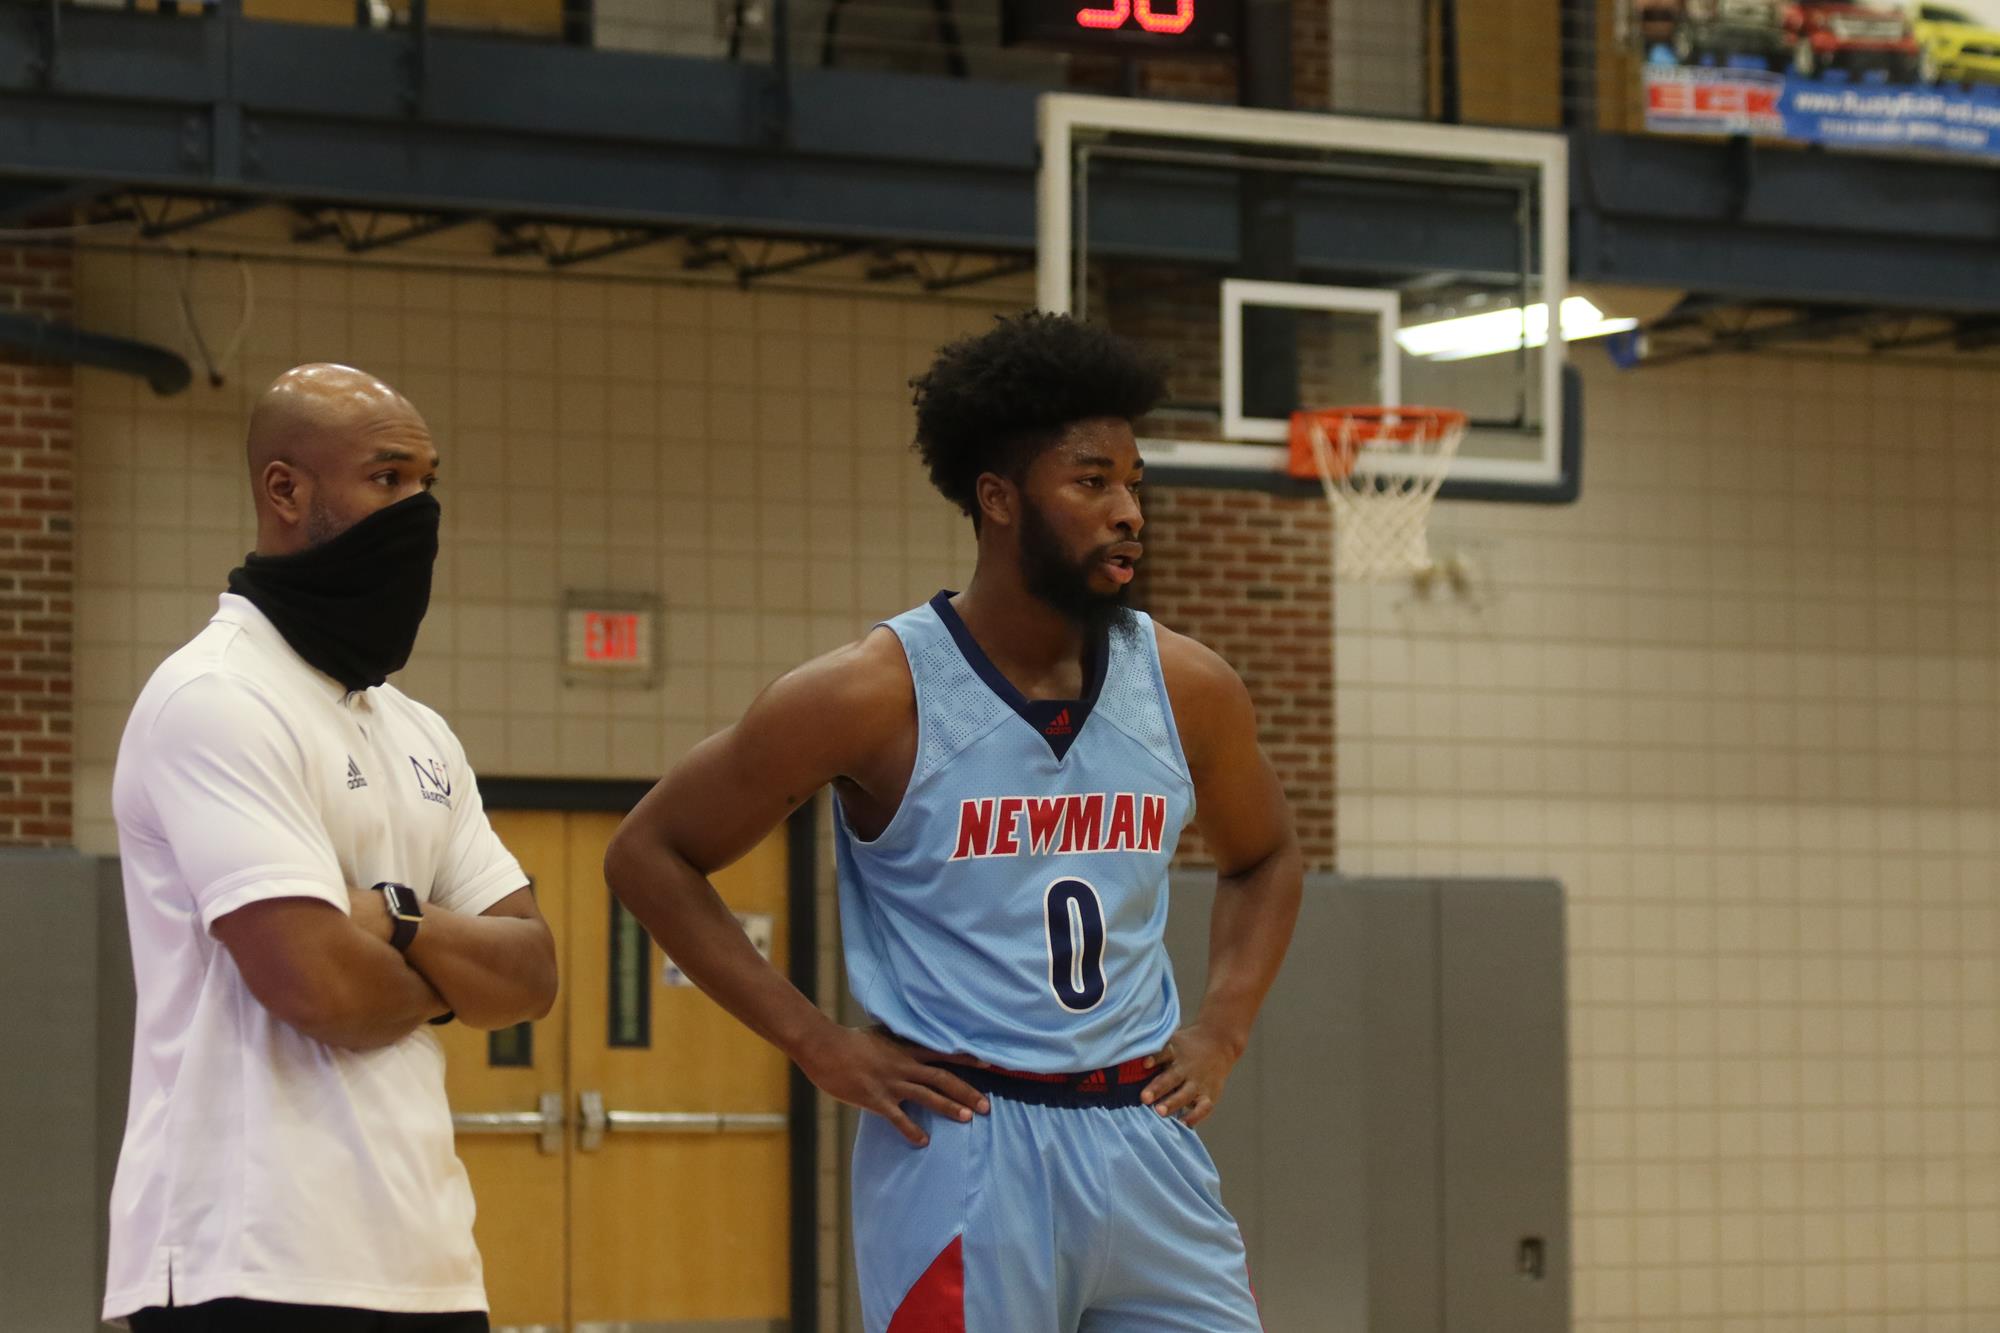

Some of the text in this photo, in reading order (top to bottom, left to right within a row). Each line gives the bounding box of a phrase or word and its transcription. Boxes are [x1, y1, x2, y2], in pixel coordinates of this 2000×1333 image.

[584, 612, 639, 659] EXIT
[948, 792, 1166, 862] NEWMAN
[1043, 876, 1107, 1014] 0
